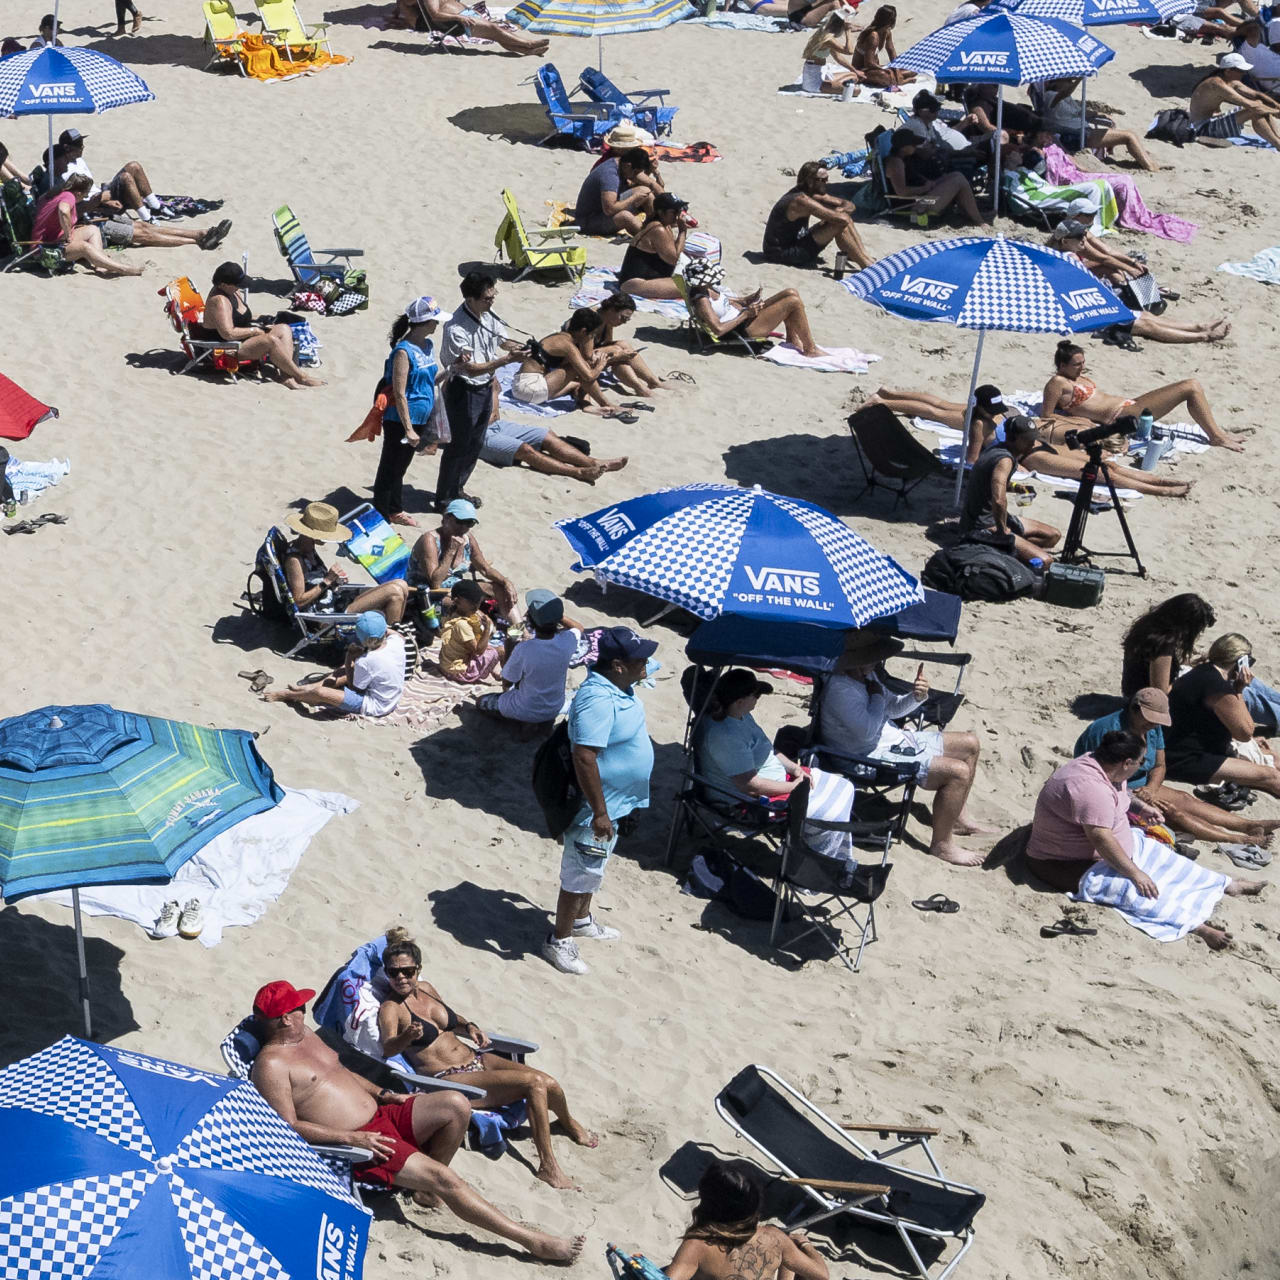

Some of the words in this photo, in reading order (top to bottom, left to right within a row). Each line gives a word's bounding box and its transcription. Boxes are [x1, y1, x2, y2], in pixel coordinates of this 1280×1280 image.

[1088, 10, 1109, 18] "OFF
[1126, 7, 1149, 15] WALL"
[959, 51, 1011, 66] VANS
[29, 82, 76, 97] VANS
[899, 274, 959, 300] VANS
[879, 289, 903, 301] "OFF
[904, 294, 921, 304] THE
[923, 297, 952, 311] WALL"
[1061, 287, 1107, 310] VANS
[1069, 311, 1087, 321] "OFF
[1087, 309, 1101, 318] THE
[1101, 306, 1119, 316] WALL"
[597, 507, 636, 541] VANS
[743, 565, 820, 596] VANS
[733, 592, 764, 604] "OFF
[766, 595, 791, 606] THE
[794, 598, 835, 612] WALL"
